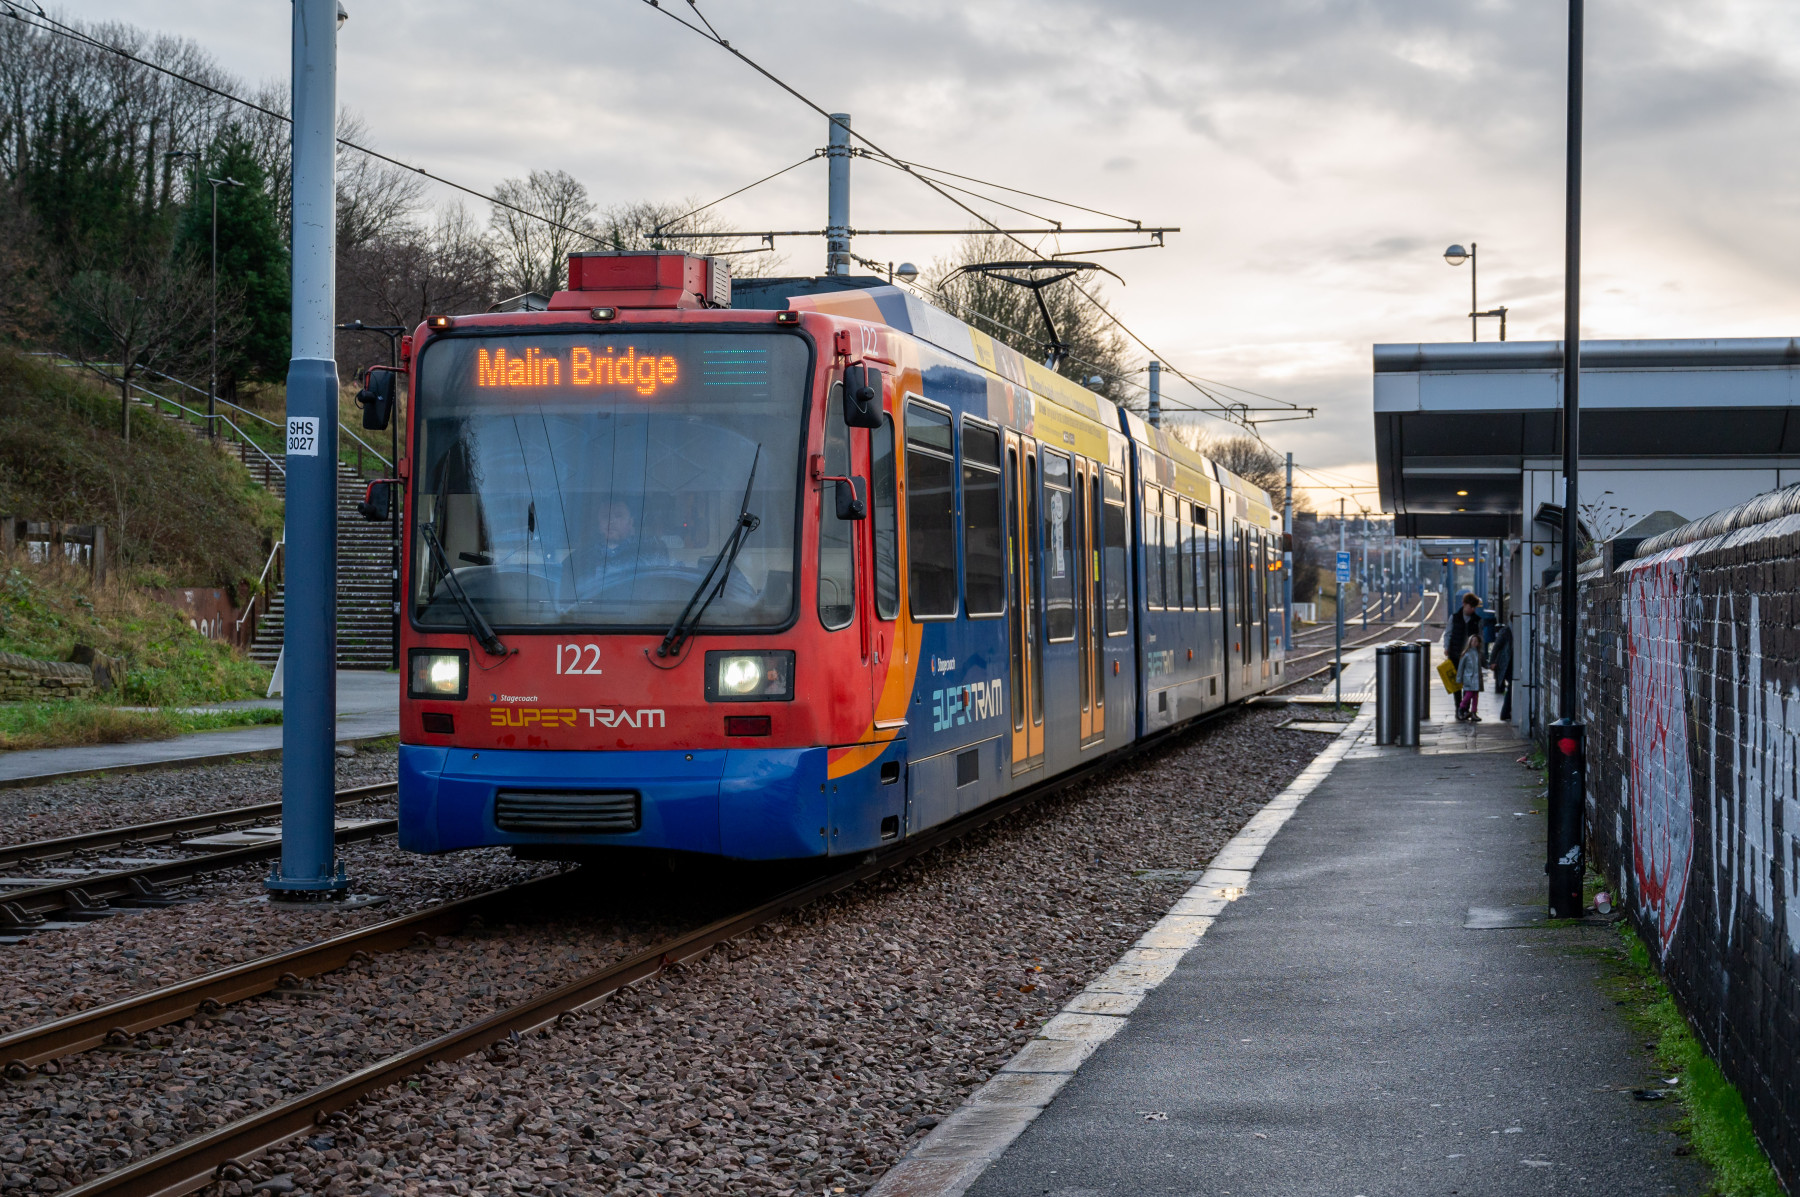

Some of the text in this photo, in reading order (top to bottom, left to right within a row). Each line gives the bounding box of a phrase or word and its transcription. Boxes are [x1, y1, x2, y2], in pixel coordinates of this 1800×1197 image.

[859, 324, 879, 357] 122
[479, 346, 678, 394] Malin Bridge
[289, 421, 314, 435] SHS
[288, 436, 315, 451] 3027
[556, 643, 602, 675] 122
[500, 694, 538, 704] Stagecoach
